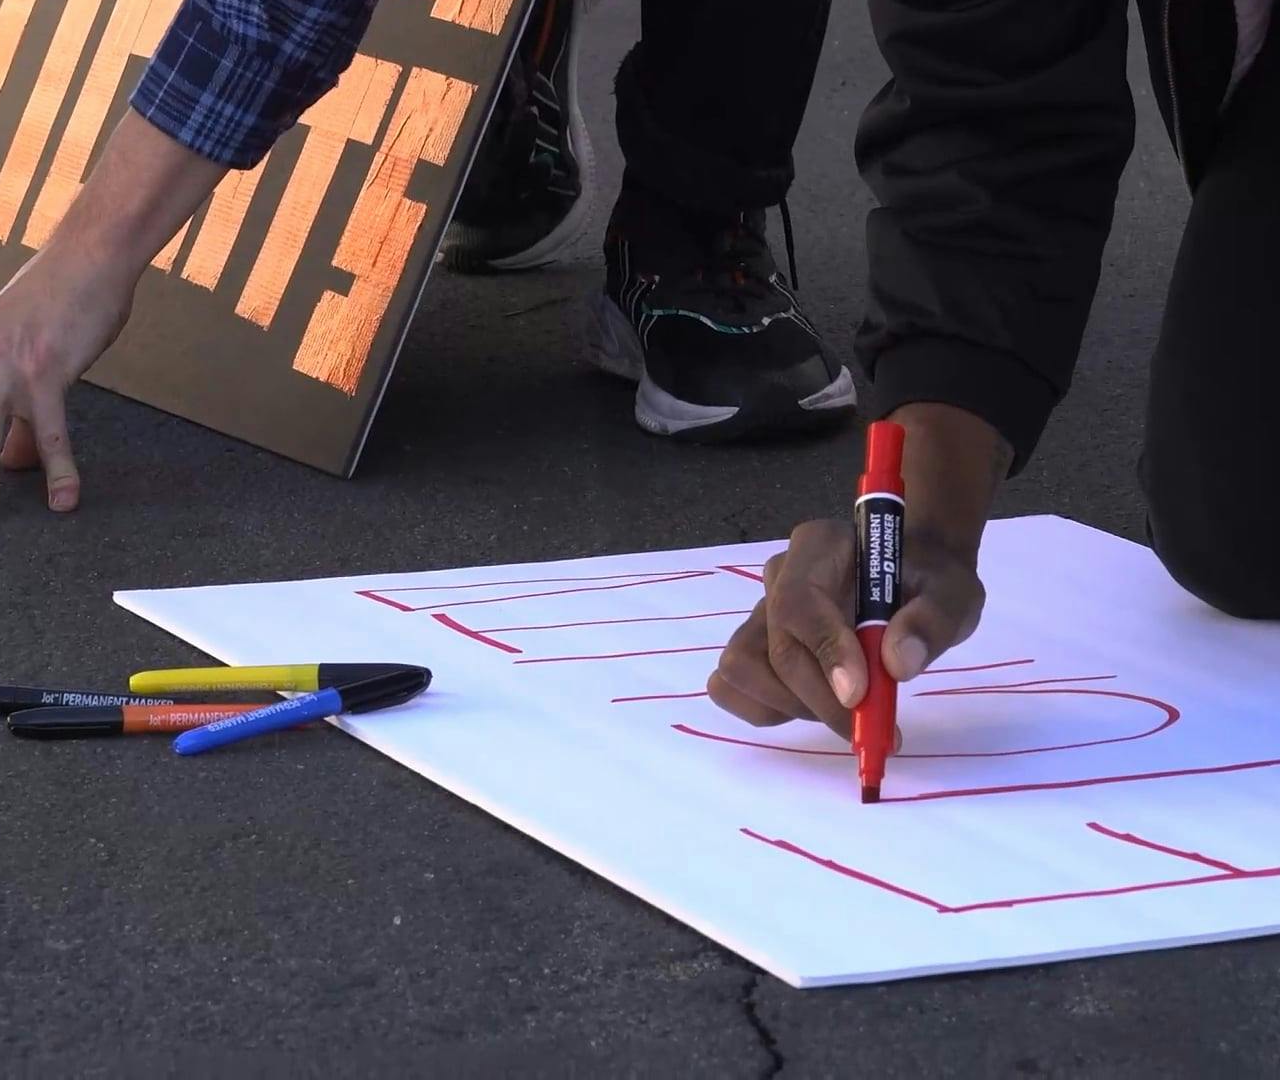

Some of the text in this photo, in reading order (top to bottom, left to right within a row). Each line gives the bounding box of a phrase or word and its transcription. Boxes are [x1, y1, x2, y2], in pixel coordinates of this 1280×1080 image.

[870, 512, 881, 579] PERMANENT
[884, 513, 895, 560] MARKER
[62, 693, 129, 707] PERMANENT
